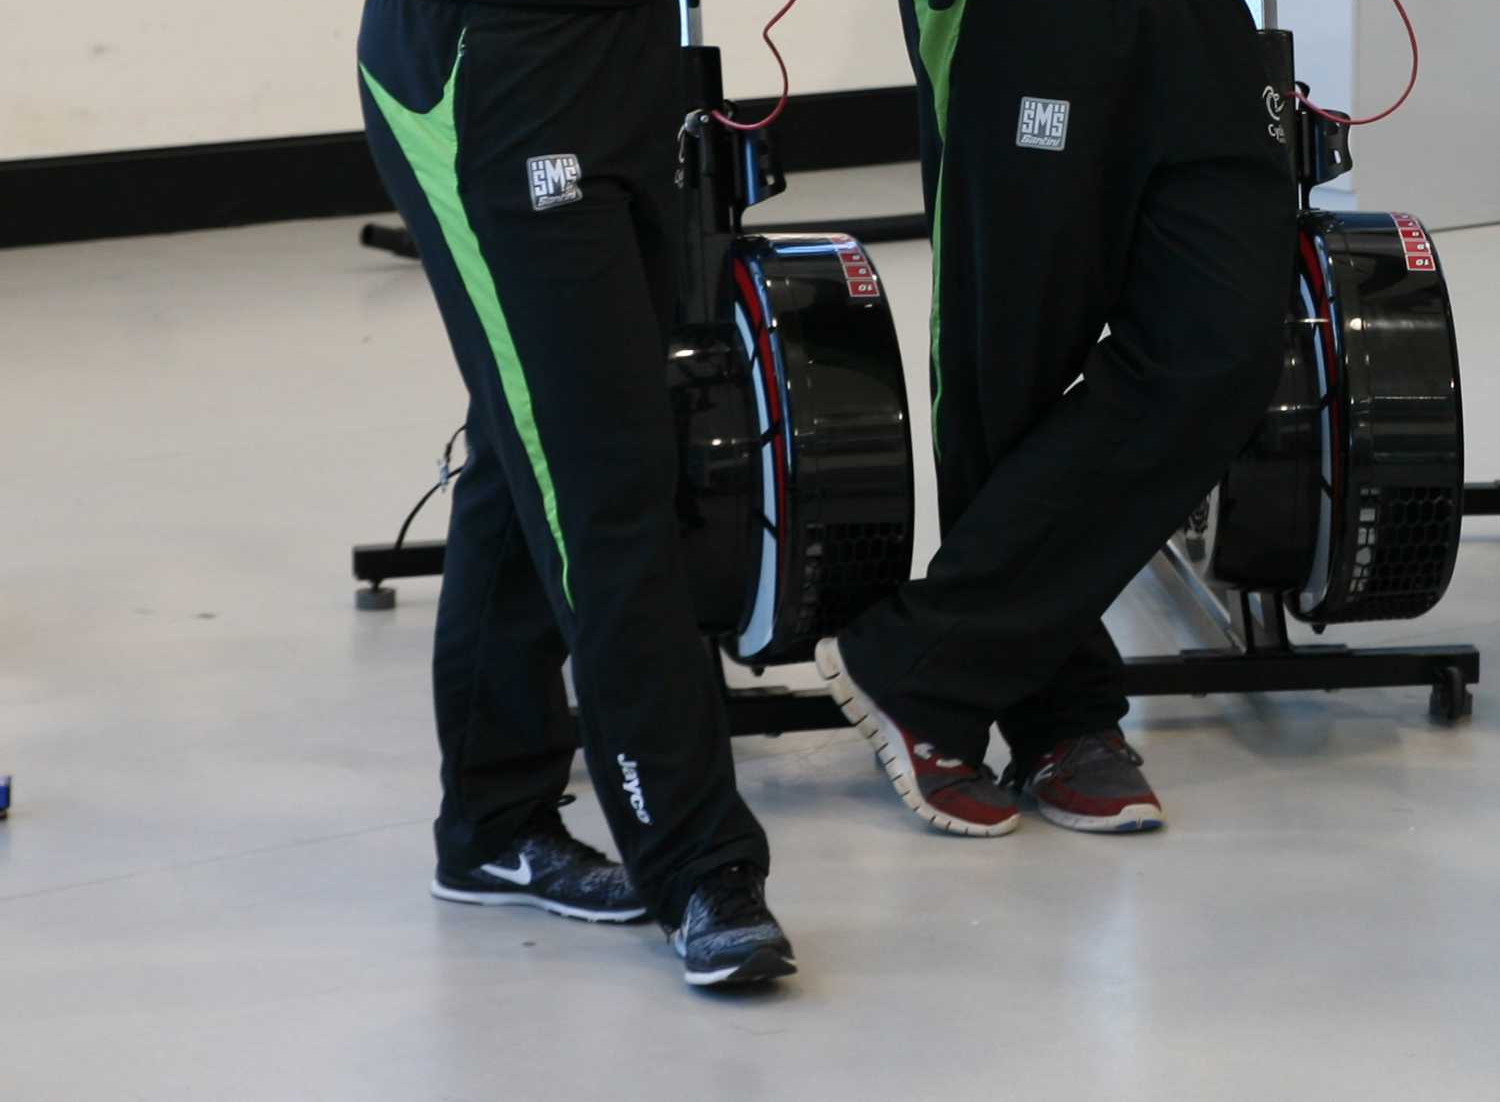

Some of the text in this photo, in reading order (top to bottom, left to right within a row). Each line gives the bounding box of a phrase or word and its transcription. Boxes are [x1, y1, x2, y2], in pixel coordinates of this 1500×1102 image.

[1020, 100, 1066, 138] SMS
[1020, 134, 1061, 147] Santini
[617, 753, 650, 824] Jayco
